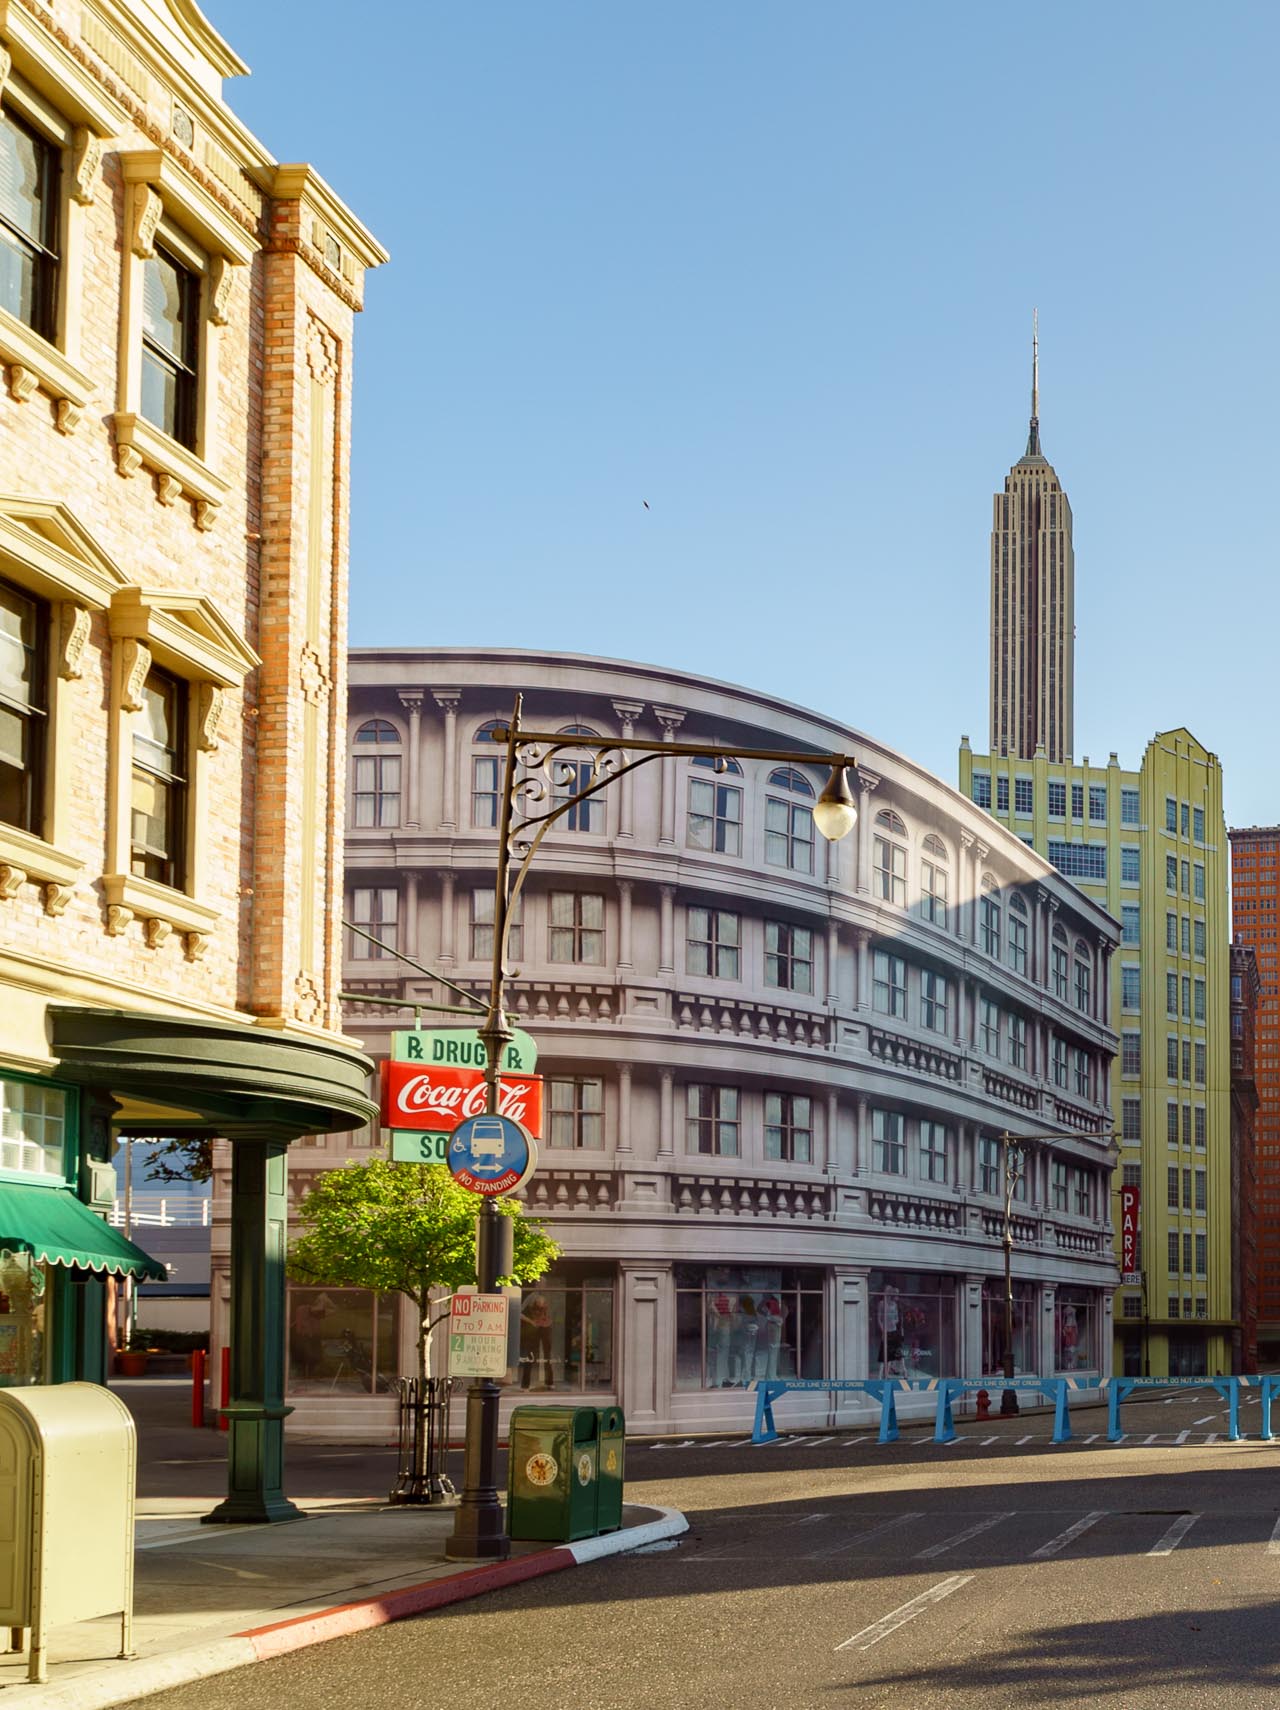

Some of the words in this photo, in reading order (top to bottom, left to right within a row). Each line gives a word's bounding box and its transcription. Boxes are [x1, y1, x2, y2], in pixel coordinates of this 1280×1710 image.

[397, 1074, 531, 1121] Coca-Cla
[459, 1172, 473, 1186] NO
[474, 1173, 517, 1192] STANDING
[1123, 1193, 1134, 1267] PARK
[455, 1299, 470, 1314] NO
[472, 1301, 504, 1313] PARKING
[456, 1319, 461, 1330] 7
[464, 1323, 474, 1331] TO
[477, 1319, 483, 1331] 9
[455, 1336, 461, 1351] 2
[471, 1336, 496, 1344] HOUR
[466, 1344, 501, 1353] PARKING
